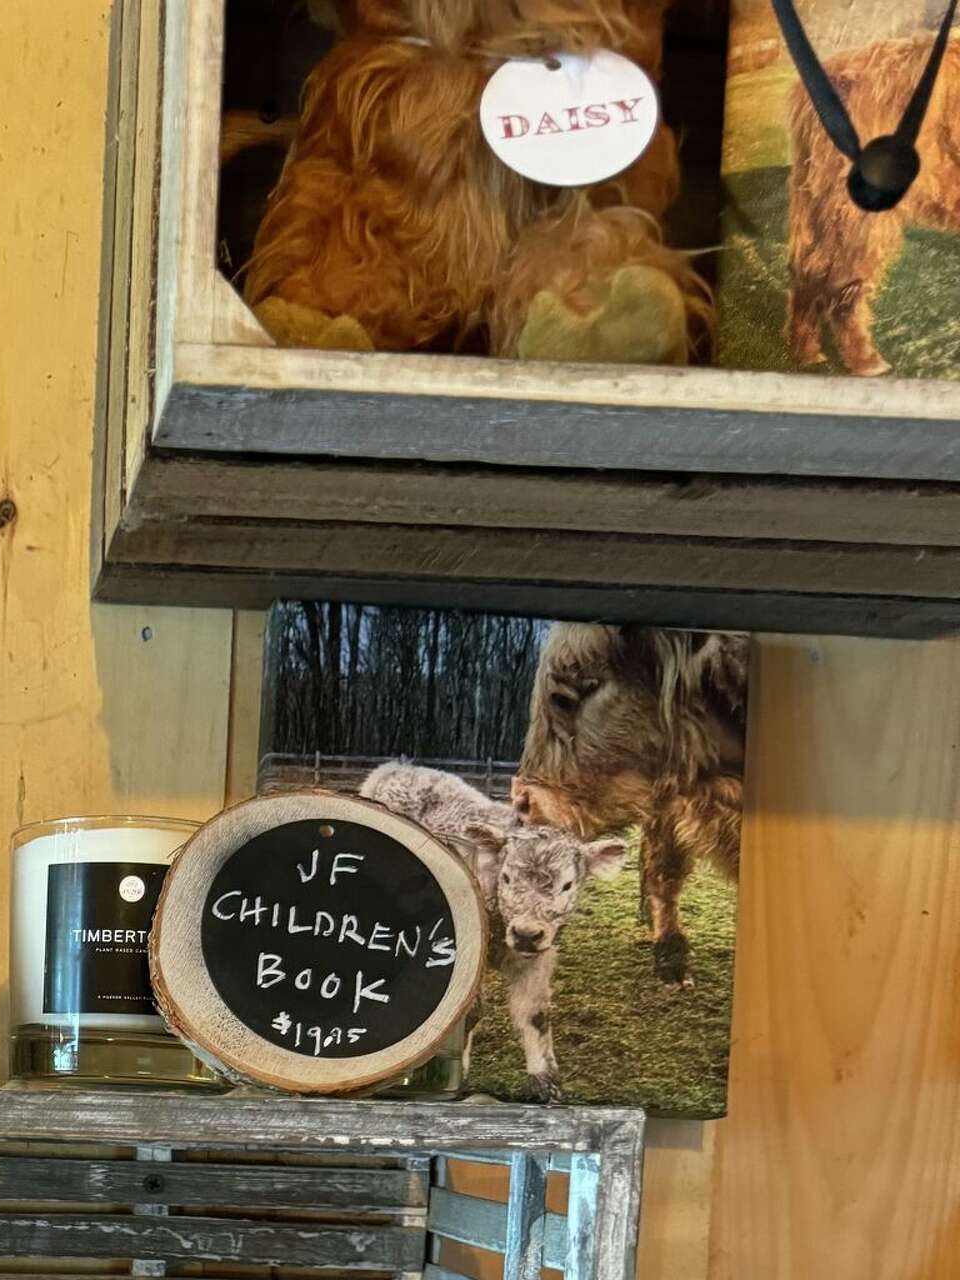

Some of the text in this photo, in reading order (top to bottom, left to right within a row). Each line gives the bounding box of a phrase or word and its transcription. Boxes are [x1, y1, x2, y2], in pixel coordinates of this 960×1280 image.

[498, 96, 643, 140] DAISY
[296, 849, 365, 886] JF
[71, 928, 148, 944] TIMBERT
[211, 890, 457, 968] CHILDREN'S
[256, 951, 390, 1014] BOOK
